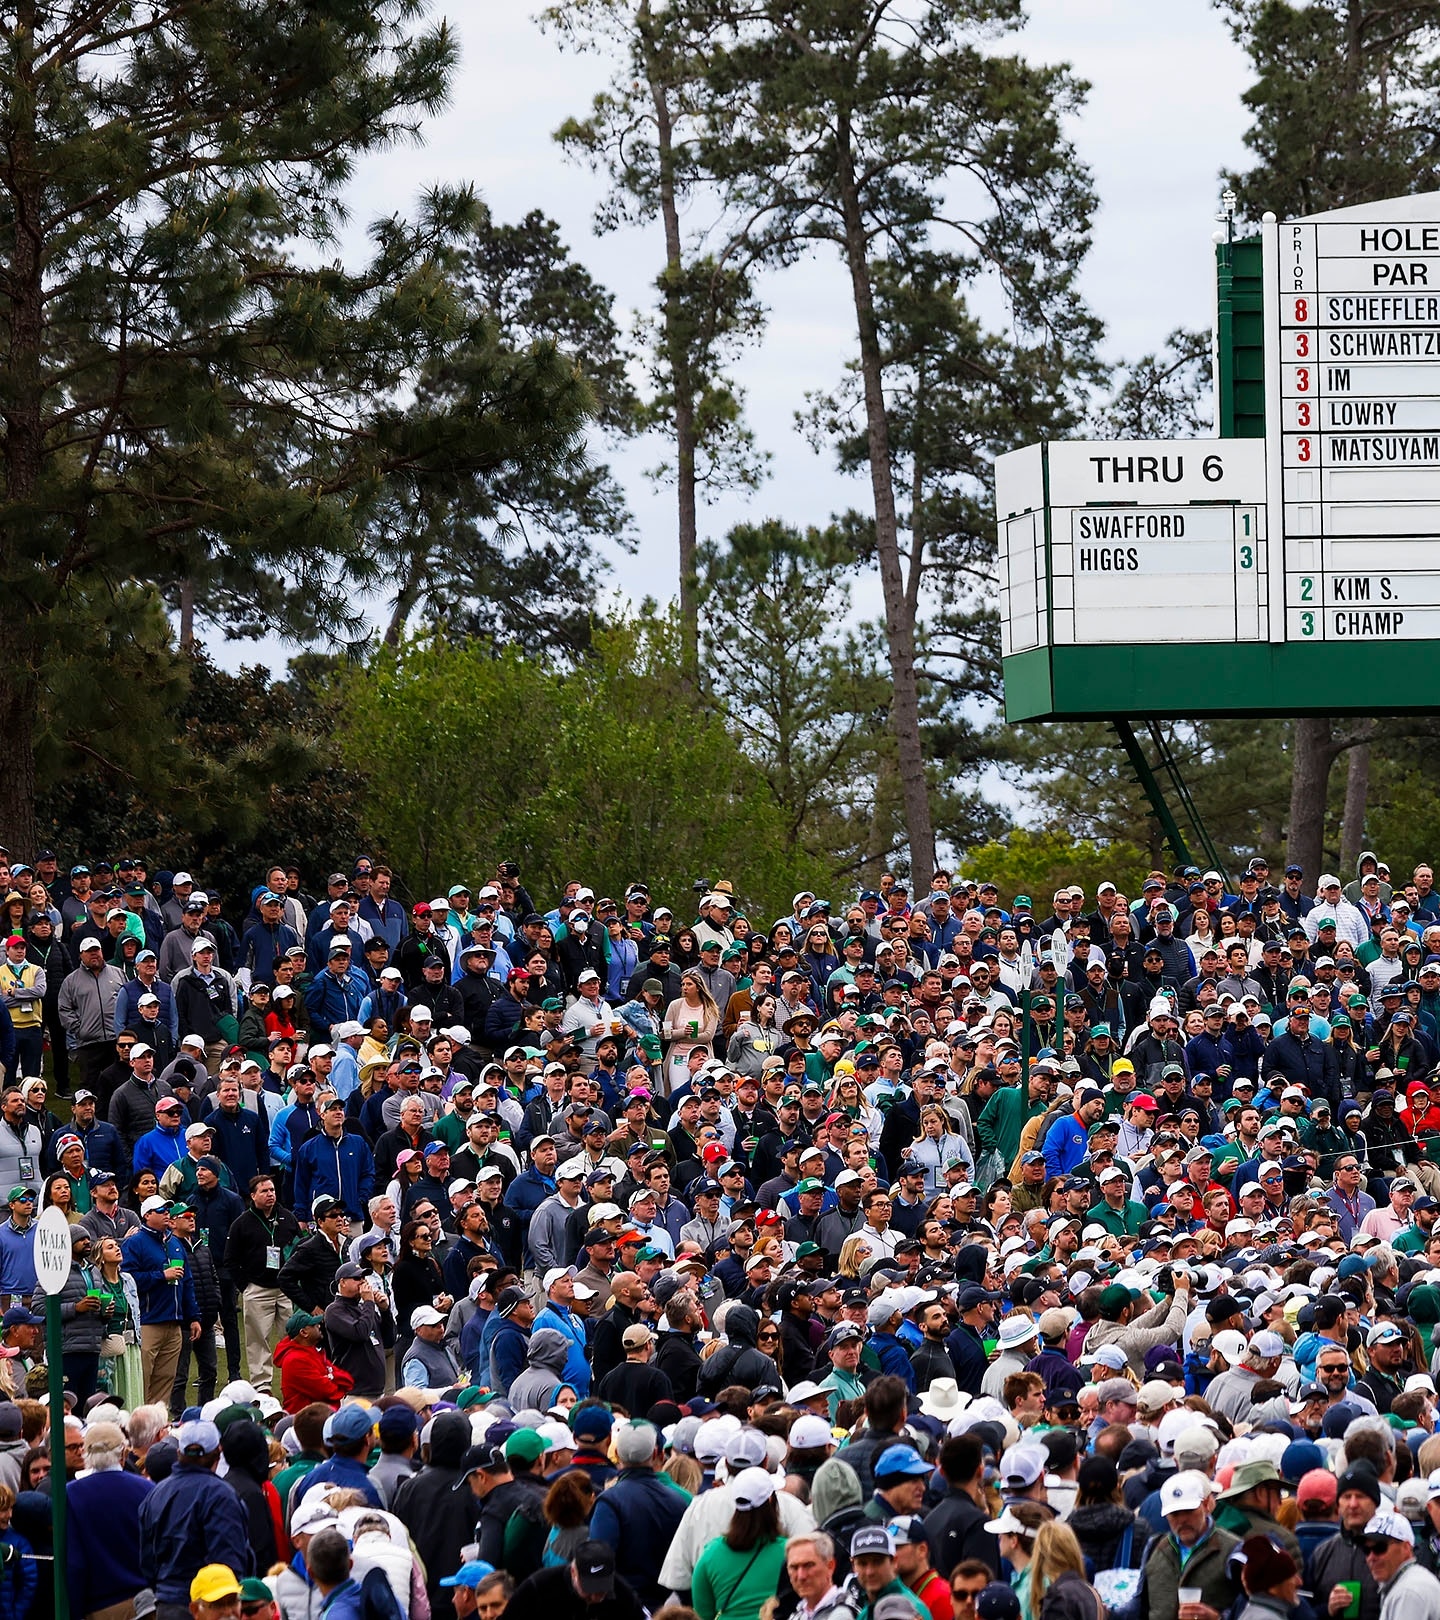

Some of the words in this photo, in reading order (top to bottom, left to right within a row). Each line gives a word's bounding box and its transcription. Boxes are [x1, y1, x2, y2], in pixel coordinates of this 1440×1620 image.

[1360, 228, 1440, 252] HOLE
[1293, 226, 1304, 291] PRIOR
[1373, 263, 1428, 286] PAR
[1295, 298, 1308, 322] 8
[1328, 296, 1438, 321] SCHEFFLER
[1297, 333, 1309, 358] 3
[1297, 368, 1310, 392] 3
[1328, 368, 1351, 392] IM
[1298, 403, 1311, 427] 3
[1329, 401, 1397, 426] LOWRY
[1298, 438, 1311, 462] 3
[1089, 456, 1184, 483] THRU
[1202, 455, 1224, 483] 6
[1079, 514, 1185, 539] SWAFFORD
[1242, 513, 1250, 537] 1
[1080, 547, 1139, 571] HIGGS
[1240, 545, 1253, 569] 3
[1301, 578, 1312, 600] 2
[1333, 578, 1371, 601] KIM
[1380, 577, 1399, 600] S.
[1302, 612, 1314, 636] 3
[1335, 610, 1404, 636] CHAMP
[39, 1229, 67, 1250] WALK
[42, 1251, 64, 1271] WAY
